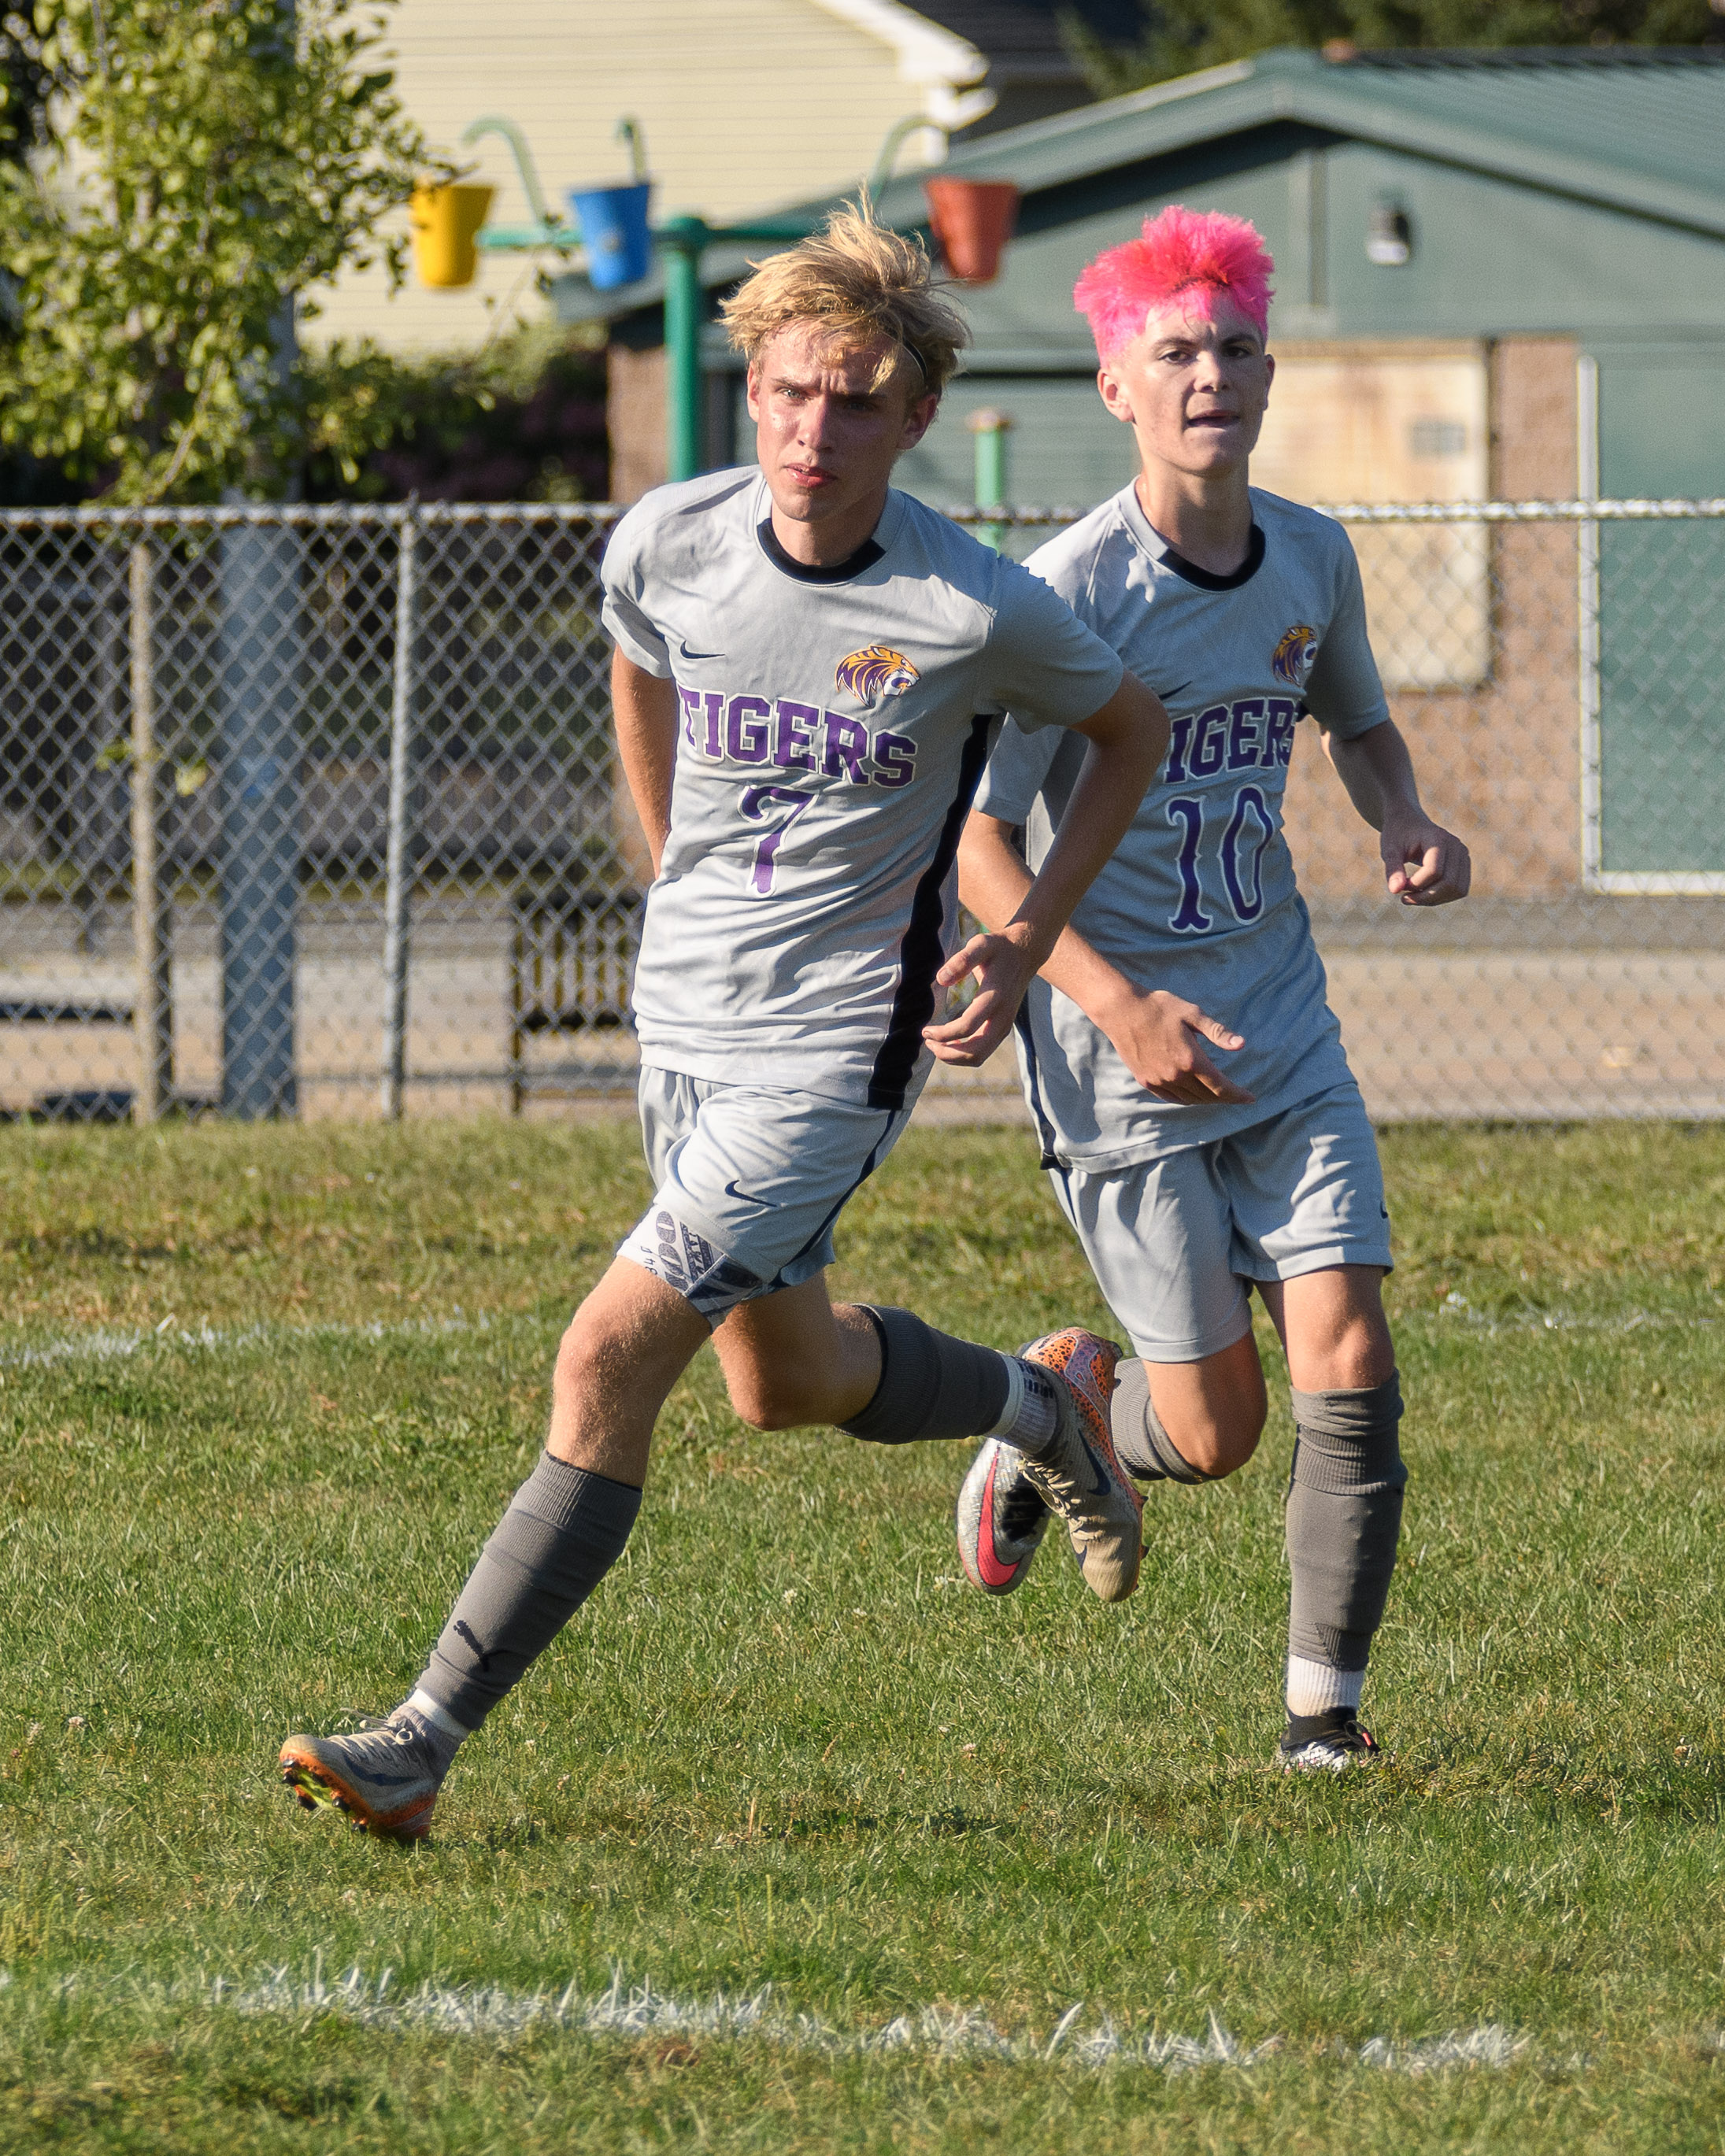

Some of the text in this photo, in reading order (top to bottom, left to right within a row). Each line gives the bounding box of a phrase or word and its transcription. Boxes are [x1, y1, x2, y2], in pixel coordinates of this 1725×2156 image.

[676, 679, 919, 788] TIGERS
[1164, 697, 1301, 784] IGER
[737, 784, 820, 898] 7
[1166, 783, 1275, 934] 10
